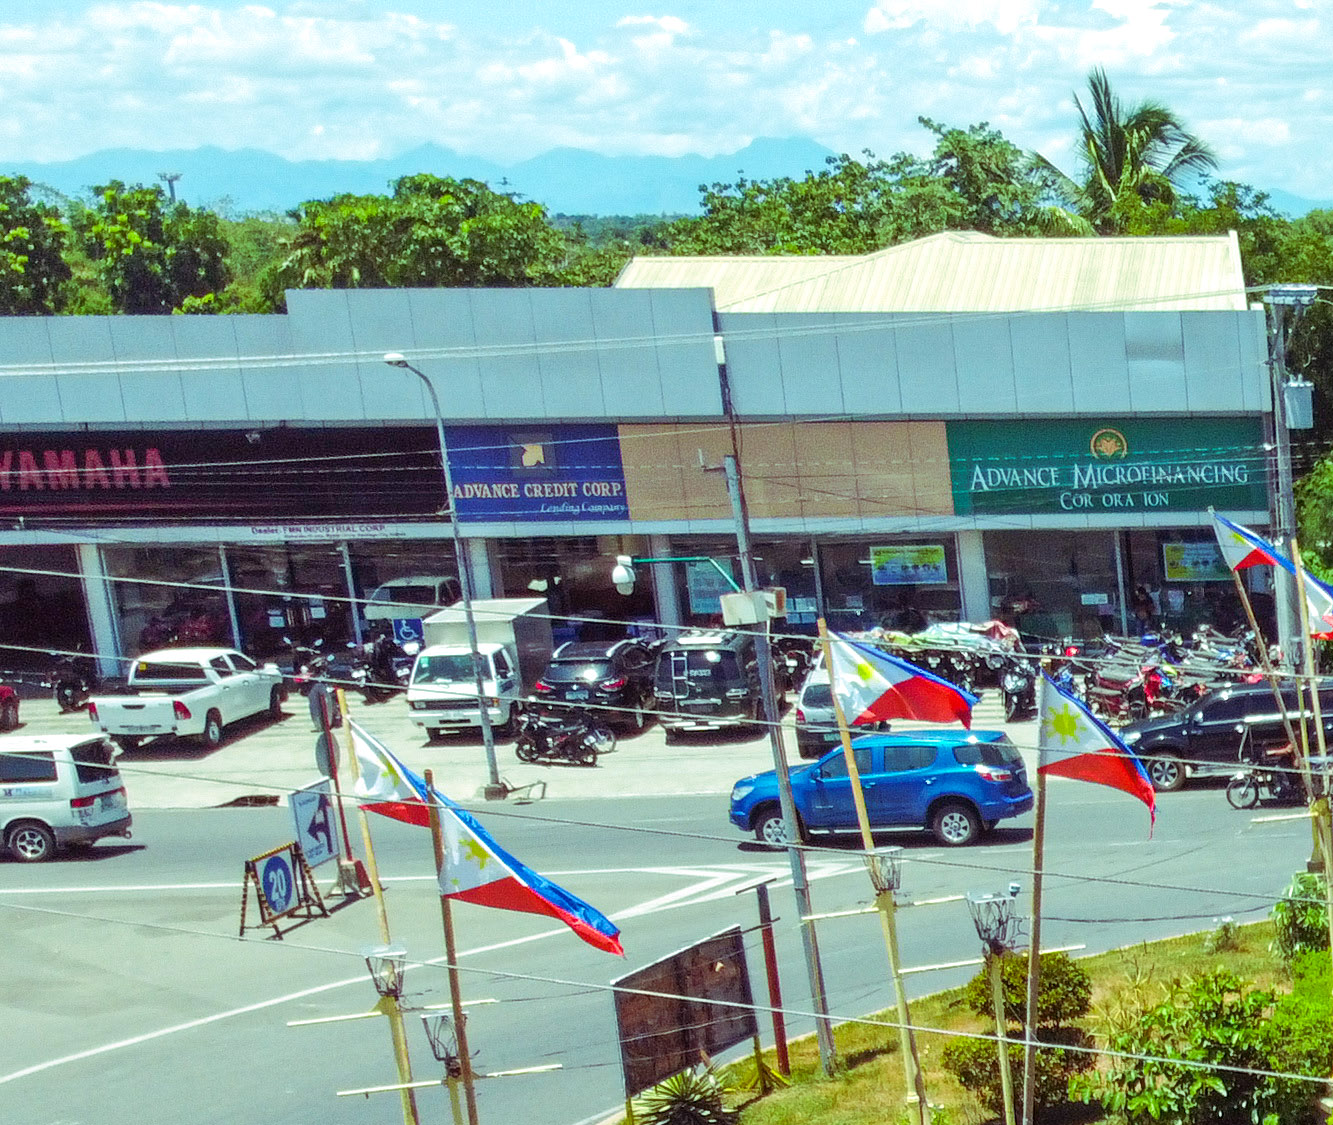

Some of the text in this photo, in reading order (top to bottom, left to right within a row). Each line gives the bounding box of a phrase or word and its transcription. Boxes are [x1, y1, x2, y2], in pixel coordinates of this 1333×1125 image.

[0, 449, 171, 490] YAMAHA
[971, 462, 1249, 491] ADVANCE MICROFINANCING
[453, 482, 624, 499] ADVANCE CREDIT CORP.
[540, 501, 628, 515] Lending Company
[304, 524, 357, 534] INDUSTRIAL
[268, 867, 287, 902] 20
